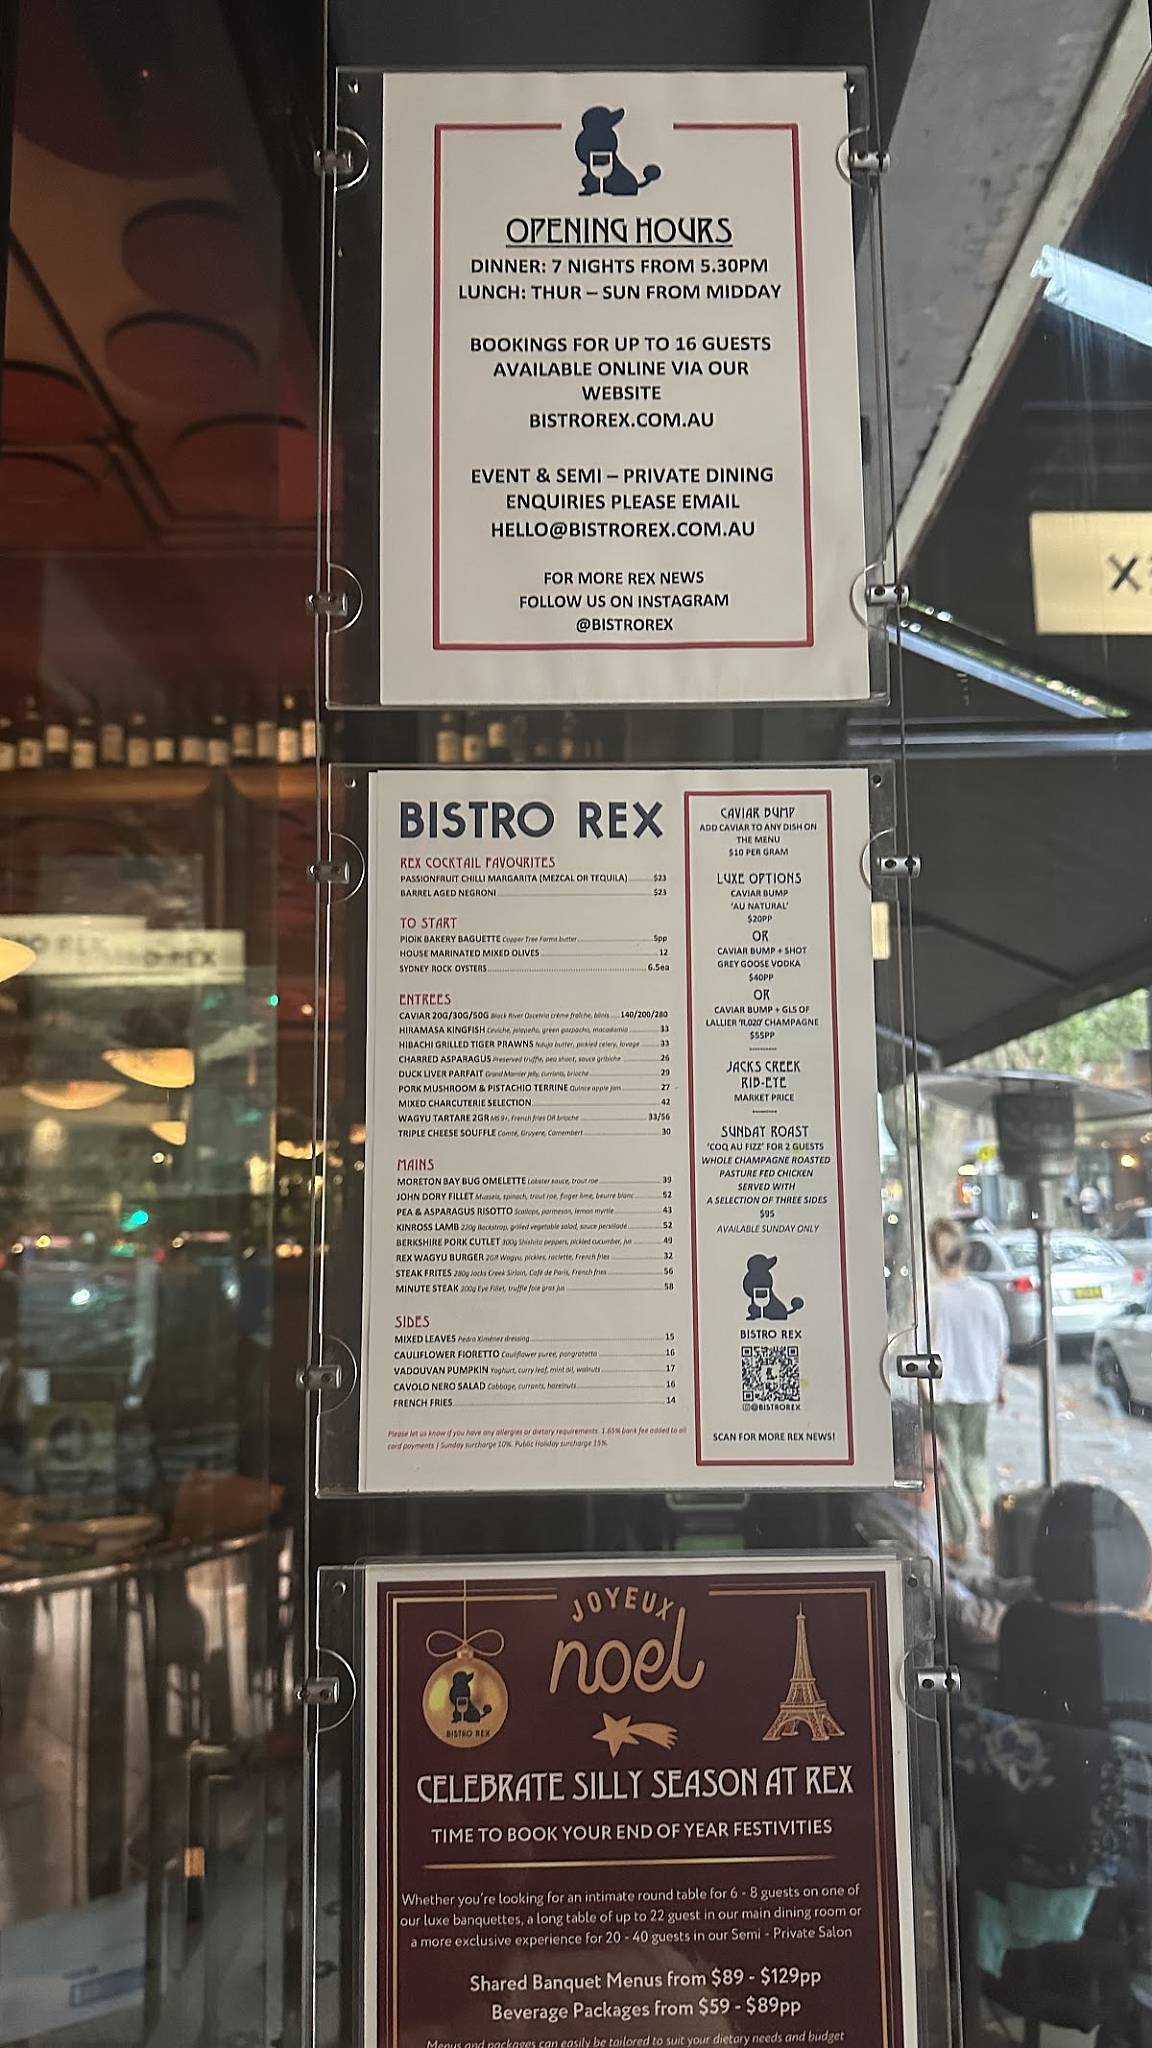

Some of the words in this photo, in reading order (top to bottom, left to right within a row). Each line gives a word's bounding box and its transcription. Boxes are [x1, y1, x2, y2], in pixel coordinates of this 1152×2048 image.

[505, 217, 627, 243] OPENING
[636, 217, 733, 243] HOURS
[471, 258, 545, 273] DINNER:
[552, 258, 561, 273] 7
[568, 258, 634, 274] NIGHTS
[641, 258, 694, 273] FROM
[700, 258, 768, 273] 5.30PM
[457, 284, 525, 299] LUNCH:
[530, 284, 581, 300] THUR
[602, 284, 639, 300] SUN
[646, 284, 699, 299] FROM
[707, 284, 782, 299] MIDDAY
[470, 337, 567, 352] BOOKINGS
[573, 337, 608, 352] FOR
[615, 336, 639, 351] UP
[644, 336, 669, 351] TO
[676, 336, 696, 351] 16
[702, 336, 771, 351] GUESTS
[492, 361, 591, 377] AVAILABLE
[598, 360, 665, 376] ONLINE
[671, 360, 703, 375] VIA
[708, 360, 748, 375] OUR
[581, 385, 661, 400] WEBSITE
[529, 412, 714, 428] BISTROREX.COM.AU
[471, 468, 530, 484] EVENT
[536, 467, 550, 483] &
[556, 467, 601, 484] SEMI
[624, 467, 699, 483] PRIVATE
[706, 466, 774, 483] DINING
[505, 493, 605, 510] ENQUIRIES
[611, 493, 676, 509] PLEASE
[682, 493, 740, 509] EMAIL
[491, 521, 756, 539] HELLO@BISTROREX.COM.AU
[544, 571, 573, 584] FOR
[578, 571, 622, 585] MORE
[628, 571, 655, 585] REX
[660, 570, 704, 584] NEWS
[518, 594, 582, 608] FOLLOW
[586, 594, 605, 608] US
[610, 594, 632, 608] ON
[638, 593, 729, 608] INSTAGRAM
[575, 617, 674, 633] @BISTROREX
[720, 806, 759, 819] CAVIAR
[764, 806, 795, 818] BUMP
[400, 801, 554, 839] BISTRO
[579, 801, 664, 839] REX
[736, 835, 752, 844] THE
[754, 835, 780, 843] MENU
[728, 847, 743, 857] $10
[746, 848, 760, 856] PER
[763, 847, 789, 856] GRAM
[400, 857, 420, 869] REX
[425, 856, 481, 869] COCKTAIL
[485, 856, 555, 868] FAVOURITES
[717, 872, 744, 885] LUXE
[749, 871, 802, 884] OPTIONS
[400, 889, 431, 897] BARREL
[433, 888, 456, 897] AGED
[458, 888, 496, 897] NEGRONI
[653, 888, 667, 896] $23
[400, 917, 416, 929] TO
[421, 916, 457, 929] START
[747, 914, 773, 923] $20PP
[399, 964, 428, 973] SYDNEY
[431, 964, 452, 973] ROCK
[455, 964, 487, 973] OYSTERS
[648, 963, 670, 971] 6.5ea
[749, 972, 774, 982] $40PP
[399, 993, 452, 1005] ENTREES
[726, 1060, 761, 1073] JACKS
[765, 1060, 801, 1073] CREEK
[741, 1076, 787, 1088] RIB-EYE
[398, 1099, 426, 1108] MIXED
[428, 1098, 485, 1108] CHARCUTERIE
[487, 1098, 532, 1107] SELECTION
[660, 1097, 670, 1106] 42
[734, 1093, 769, 1102] MARKET
[771, 1093, 795, 1102] PRICE
[721, 1125, 765, 1138] SUNDAY
[771, 1125, 809, 1138] ROAST
[397, 1158, 434, 1171] MAINS
[394, 1315, 430, 1328] SIDES
[394, 1334, 423, 1343] MIXED
[425, 1334, 457, 1343] LEAVES
[665, 1332, 675, 1341] 15
[740, 1328, 777, 1339] BISTRO
[781, 1329, 802, 1339] REX
[393, 1398, 427, 1407] FRENCH
[429, 1397, 453, 1407] FRIES
[665, 1395, 676, 1404] 14
[712, 1432, 736, 1441] SCAN
[739, 1432, 756, 1441] FOR
[758, 1432, 784, 1441] MORE
[787, 1432, 803, 1441] REX
[806, 1431, 836, 1441] NEWS!
[572, 1586, 674, 1622] JOYEUX
[550, 1606, 705, 1695] noel
[446, 1729, 473, 1738] BISTRO
[475, 1729, 491, 1738] REX
[416, 1772, 564, 1804] CELEBRATE
[572, 1770, 642, 1800] SILLY
[651, 1767, 757, 1798] SEASON
[766, 1766, 797, 1796] AT
[806, 1765, 855, 1794] REX
[431, 1827, 473, 1844] TIME
[477, 1826, 502, 1843] TO
[508, 1825, 557, 1842] BOOK
[562, 1824, 611, 1841] YOUR
[617, 1823, 652, 1840] END
[657, 1822, 679, 1839] OF
[684, 1821, 728, 1838] YEAR
[734, 1818, 833, 1837] FESTIVITIES
[410, 1938, 417, 1948] a
[420, 1937, 451, 1947] more
[455, 1936, 511, 1947] exclusive
[515, 1935, 581, 1946] experience
[585, 1931, 602, 1944] for
[605, 1930, 620, 1943] 20
[632, 1930, 648, 1943] 40
[651, 1931, 690, 1945] guests
[693, 1932, 704, 1941] in
[708, 1931, 728, 1941] our
[731, 1926, 760, 1940] Semi
[773, 1925, 815, 1939] Private
[818, 1924, 853, 1938] Salon
[469, 1973, 526, 1992] Shared
[533, 1972, 600, 1992] Banquet
[607, 1970, 662, 1988] Menus
[667, 1969, 705, 1986] from
[711, 1966, 743, 1987] $89
[760, 1965, 822, 1988] $129pp
[491, 2002, 568, 2024] Beverage
[574, 2000, 649, 2022] Packages
[655, 1998, 693, 2016] from
[699, 1996, 729, 2016] $59
[746, 1995, 801, 2017] $89pp
